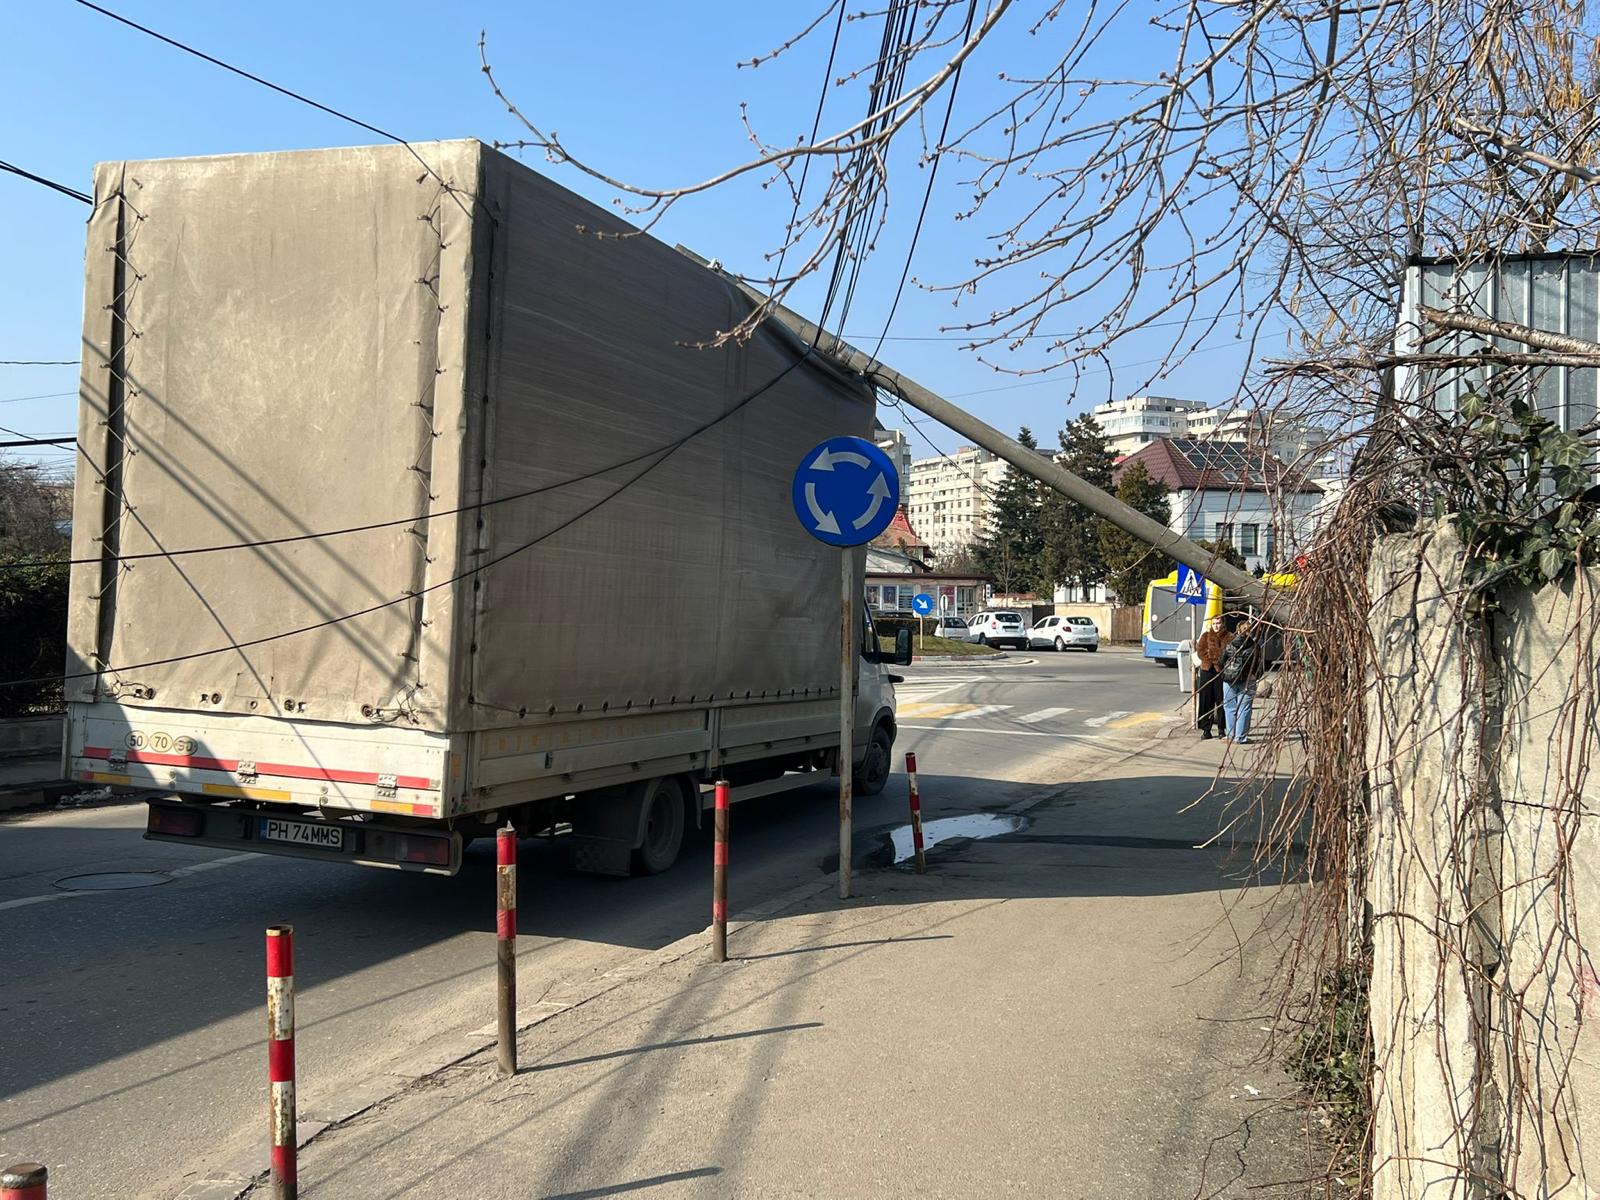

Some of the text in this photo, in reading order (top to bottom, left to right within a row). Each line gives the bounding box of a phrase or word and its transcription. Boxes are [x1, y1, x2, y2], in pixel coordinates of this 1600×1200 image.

[129, 735, 143, 747] 50
[155, 736, 168, 749] 70
[268, 821, 288, 839] PH
